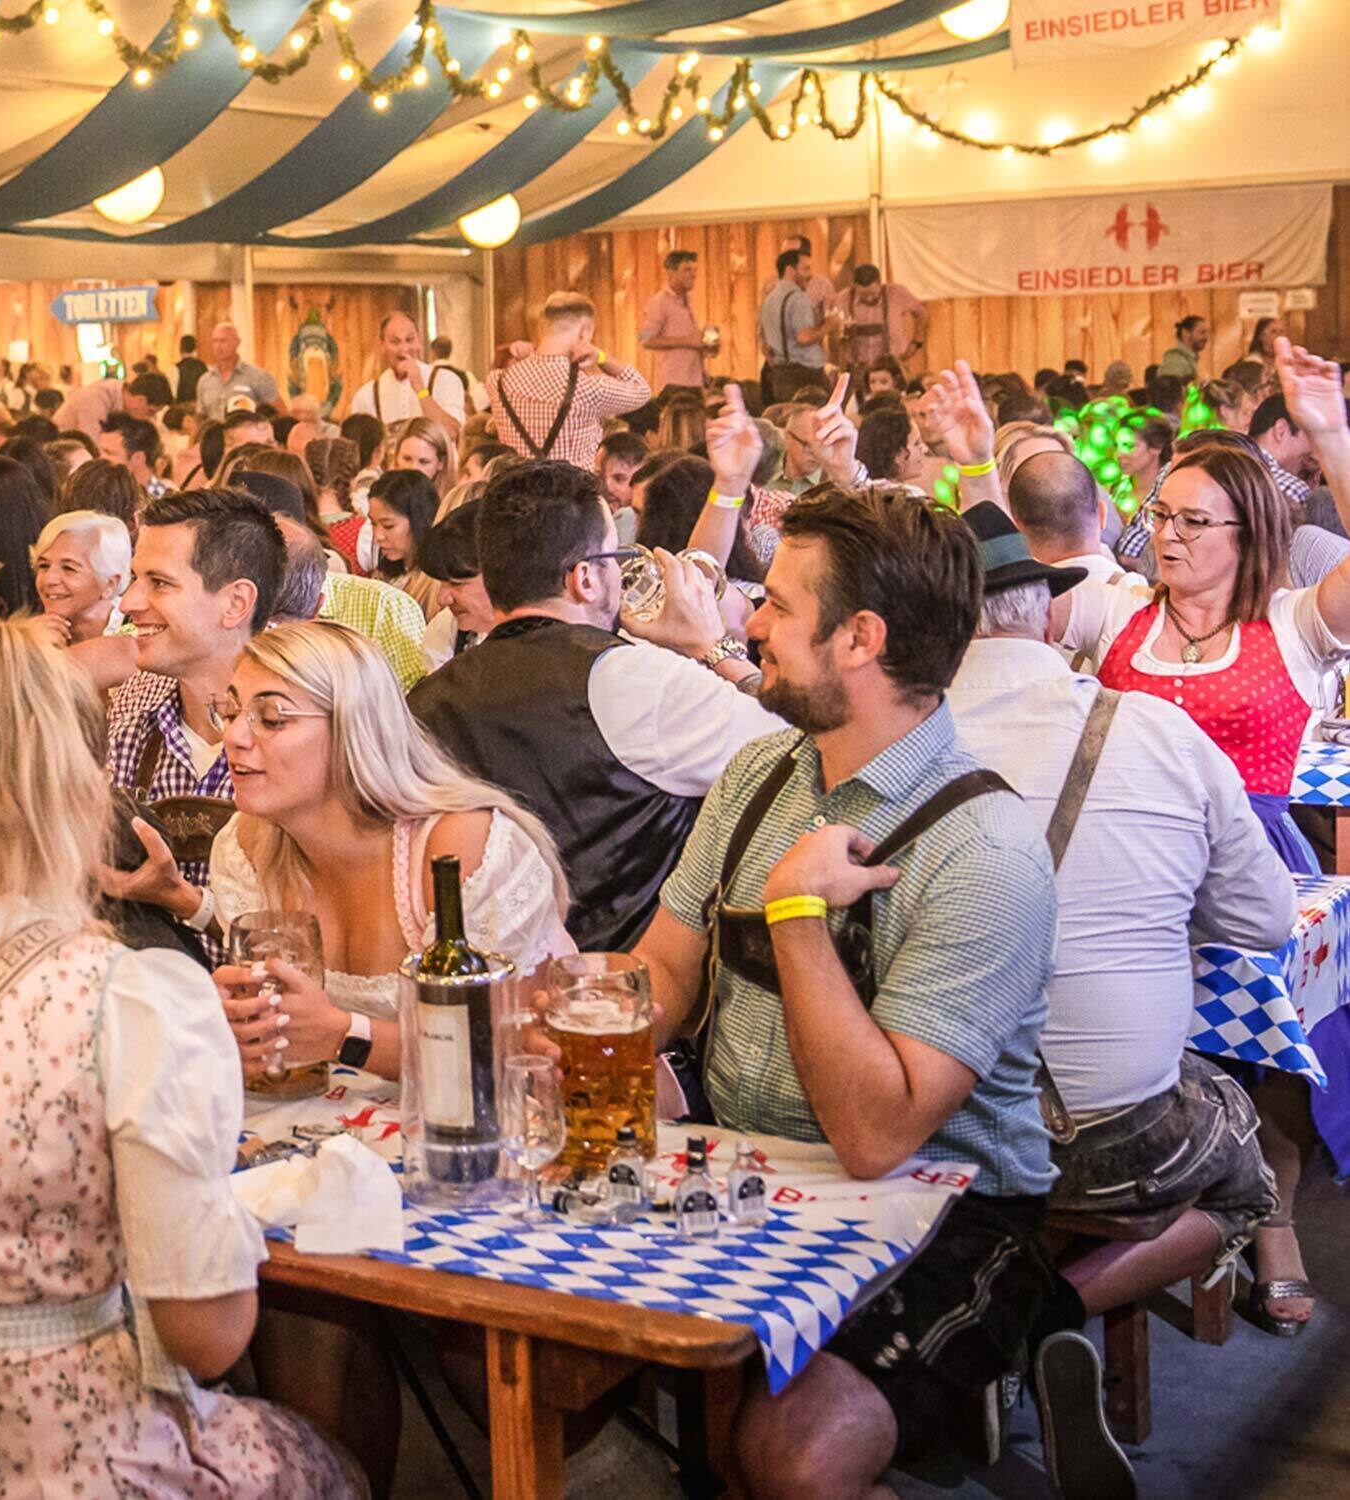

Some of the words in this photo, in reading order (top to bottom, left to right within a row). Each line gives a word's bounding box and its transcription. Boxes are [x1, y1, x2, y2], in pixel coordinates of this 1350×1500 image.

[1025, 4, 1185, 41] EINSIEDLER
[1018, 265, 1179, 290] EINSIEDLER
[1197, 262, 1264, 283] BIER
[63, 290, 148, 320] TOILETTEN
